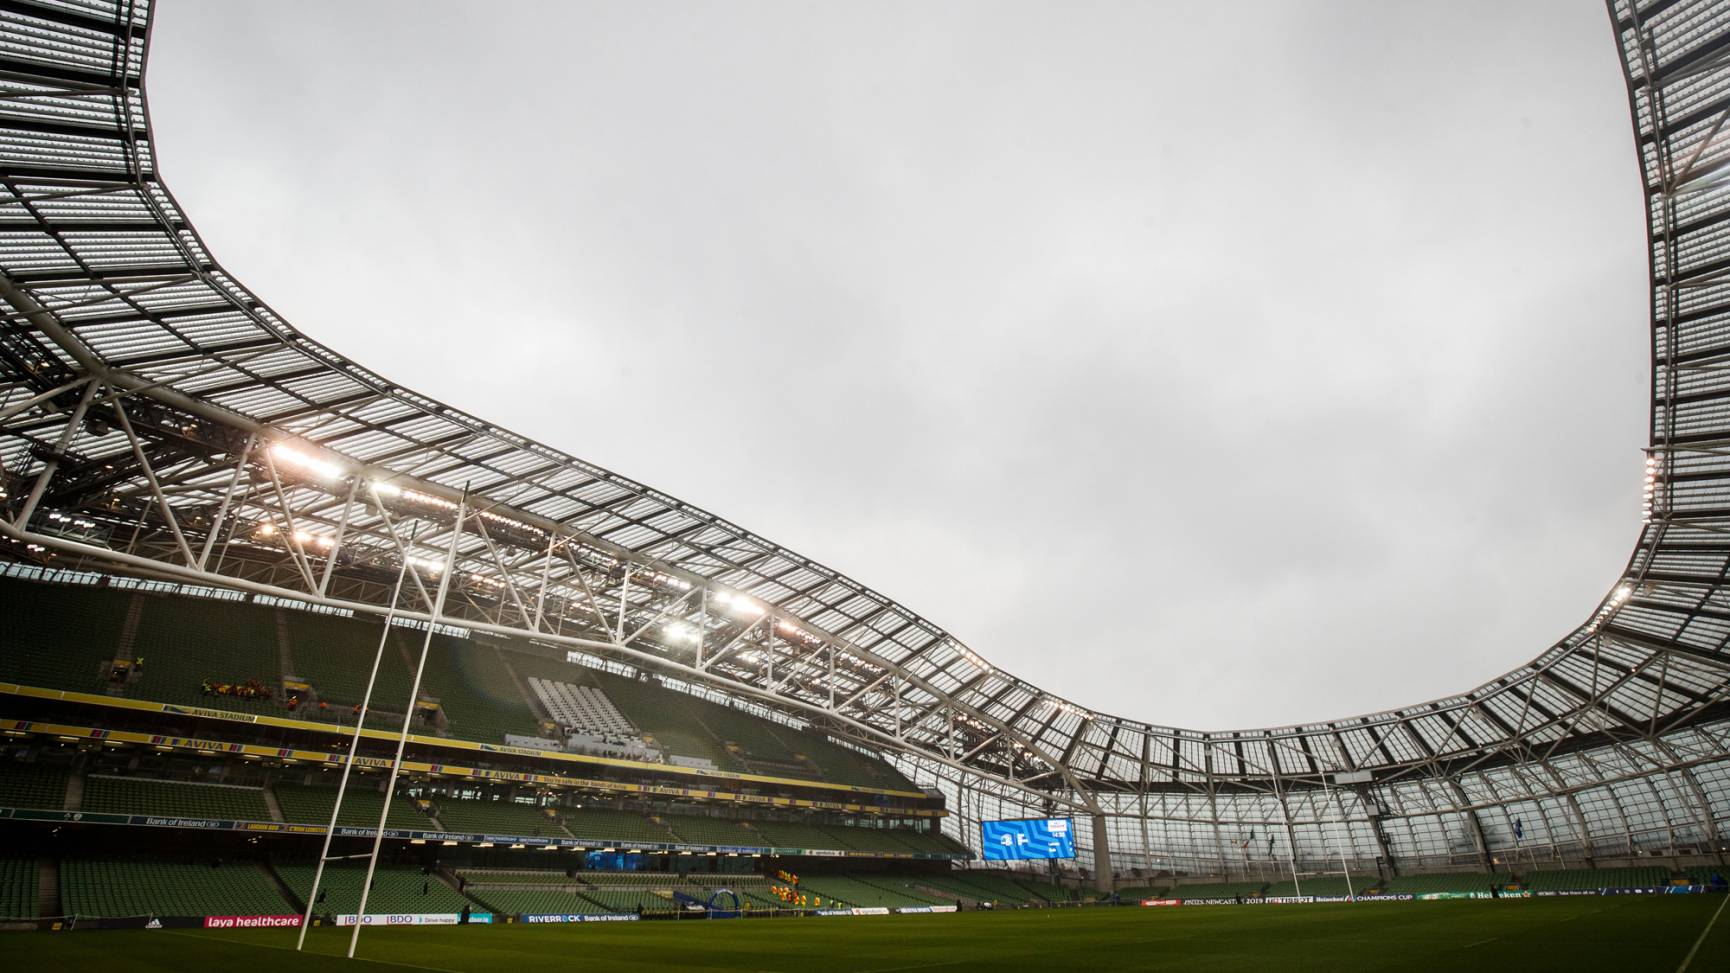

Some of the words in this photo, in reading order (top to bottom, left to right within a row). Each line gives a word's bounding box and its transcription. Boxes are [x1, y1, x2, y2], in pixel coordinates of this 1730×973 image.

[192, 708, 217, 718] AVIVA
[218, 711, 254, 722] STADIUM
[184, 740, 224, 751] AVIVA
[355, 757, 386, 767] AVIVA
[494, 771, 520, 780] AVIVA
[146, 817, 167, 825] Bank
[178, 819, 206, 827] Ireland
[341, 828, 356, 836] Bank
[423, 832, 437, 840] Bank
[445, 833, 465, 841] Ireland
[1477, 891, 1522, 900] Heieken
[208, 917, 234, 928] laya
[236, 915, 300, 927] healthcare
[389, 915, 413, 924] BDO
